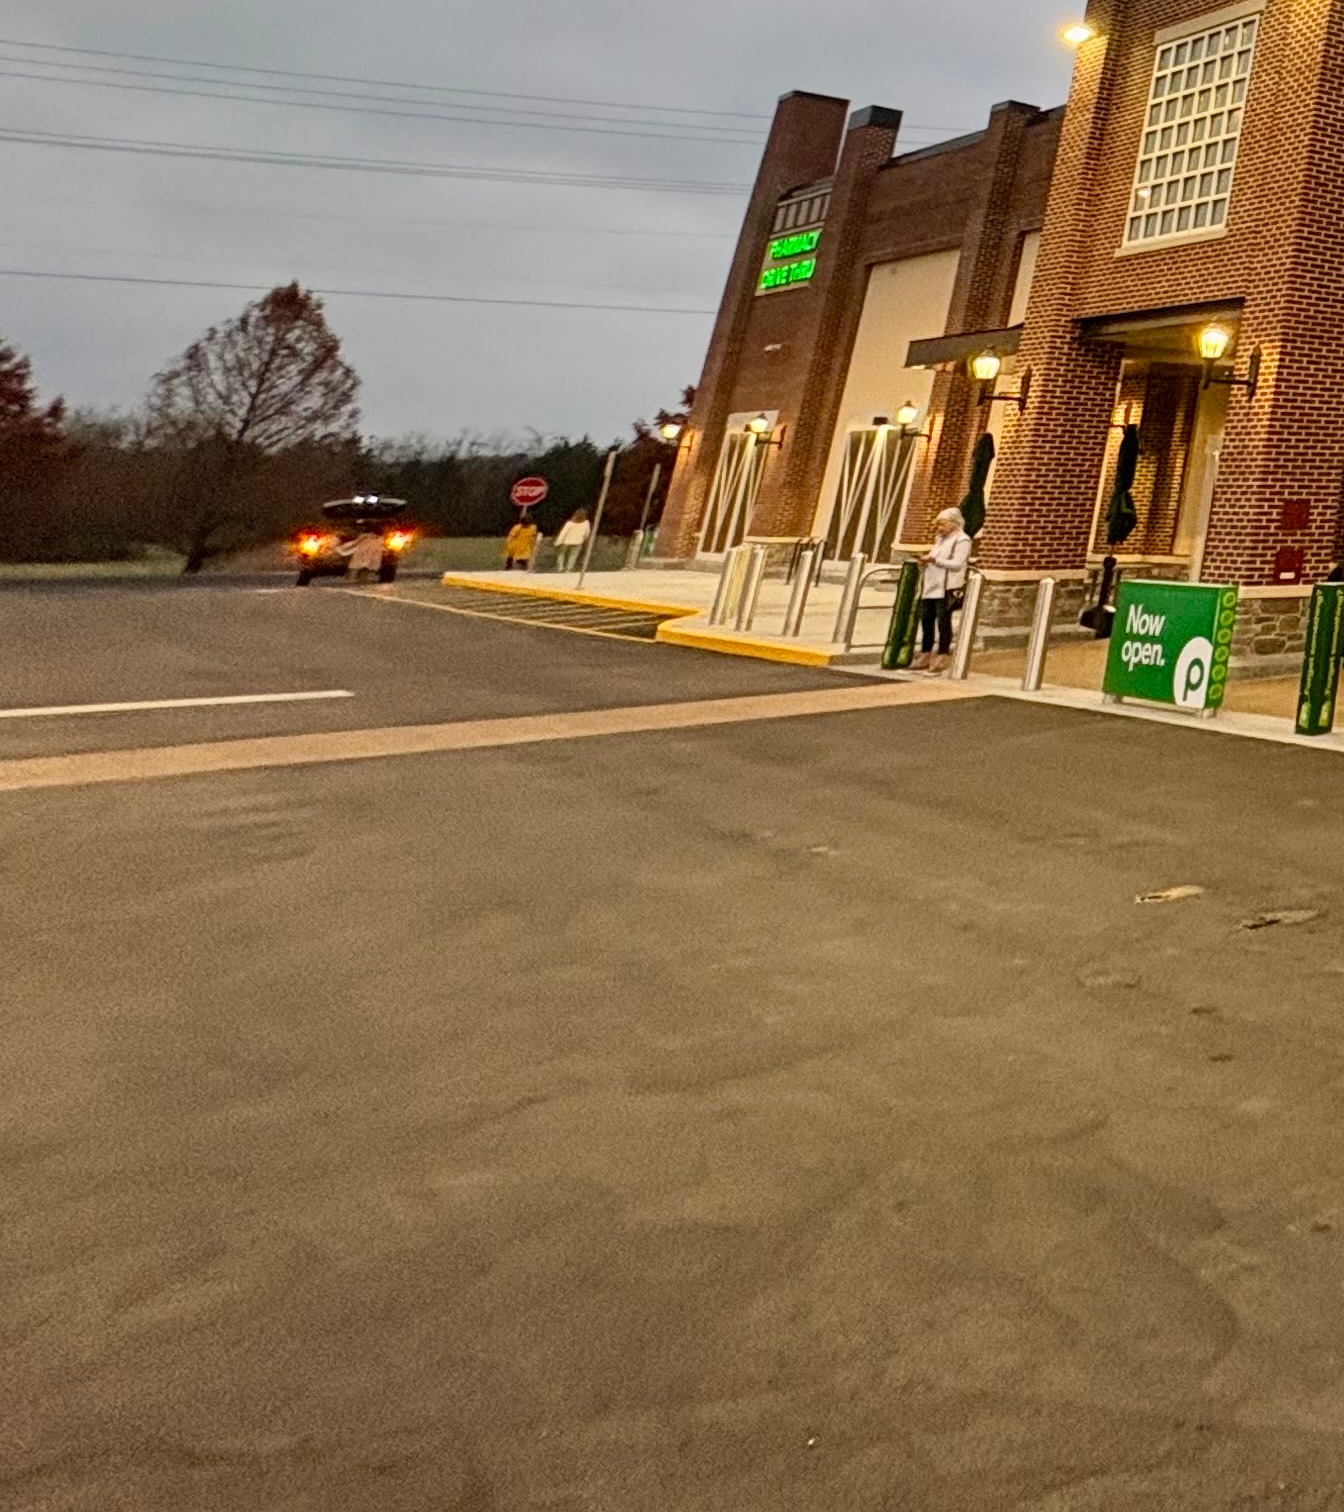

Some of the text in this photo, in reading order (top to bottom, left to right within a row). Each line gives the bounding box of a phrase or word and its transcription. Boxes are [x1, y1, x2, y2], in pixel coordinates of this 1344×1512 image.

[515, 486, 546, 497] STOP
[1126, 604, 1166, 636] Now
[1121, 641, 1166, 672] open.
